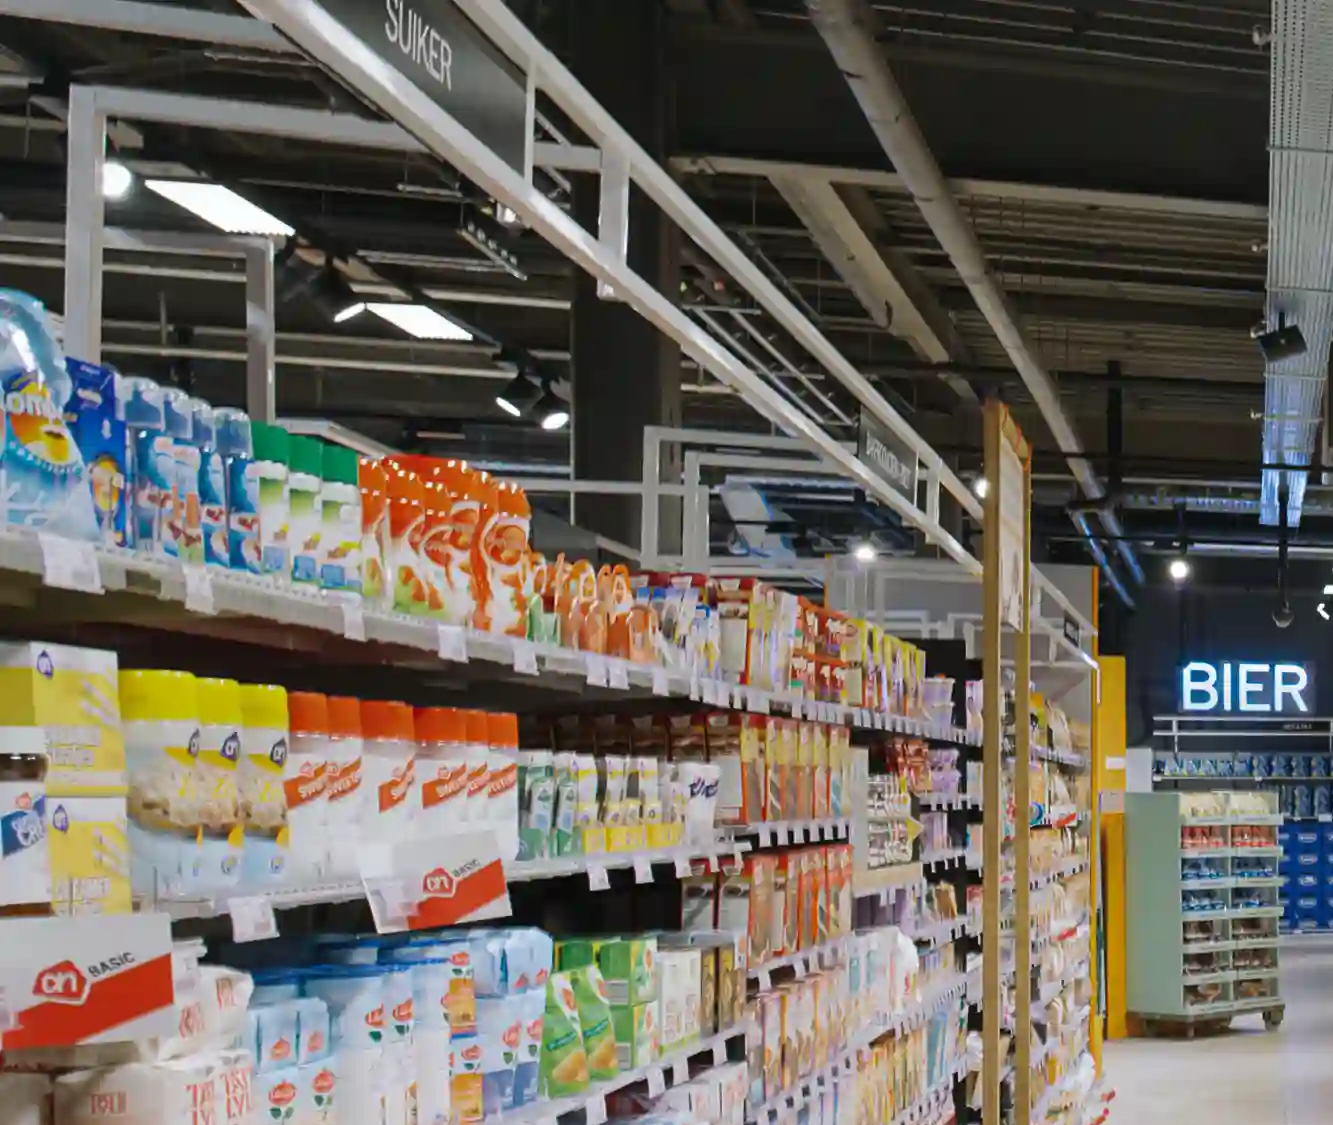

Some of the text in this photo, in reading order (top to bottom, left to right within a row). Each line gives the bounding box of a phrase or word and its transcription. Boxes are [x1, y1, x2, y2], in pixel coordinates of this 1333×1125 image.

[385, 0, 452, 92] SUIKER
[1183, 662, 1308, 712] BIER
[88, 951, 136, 978] BASIC
